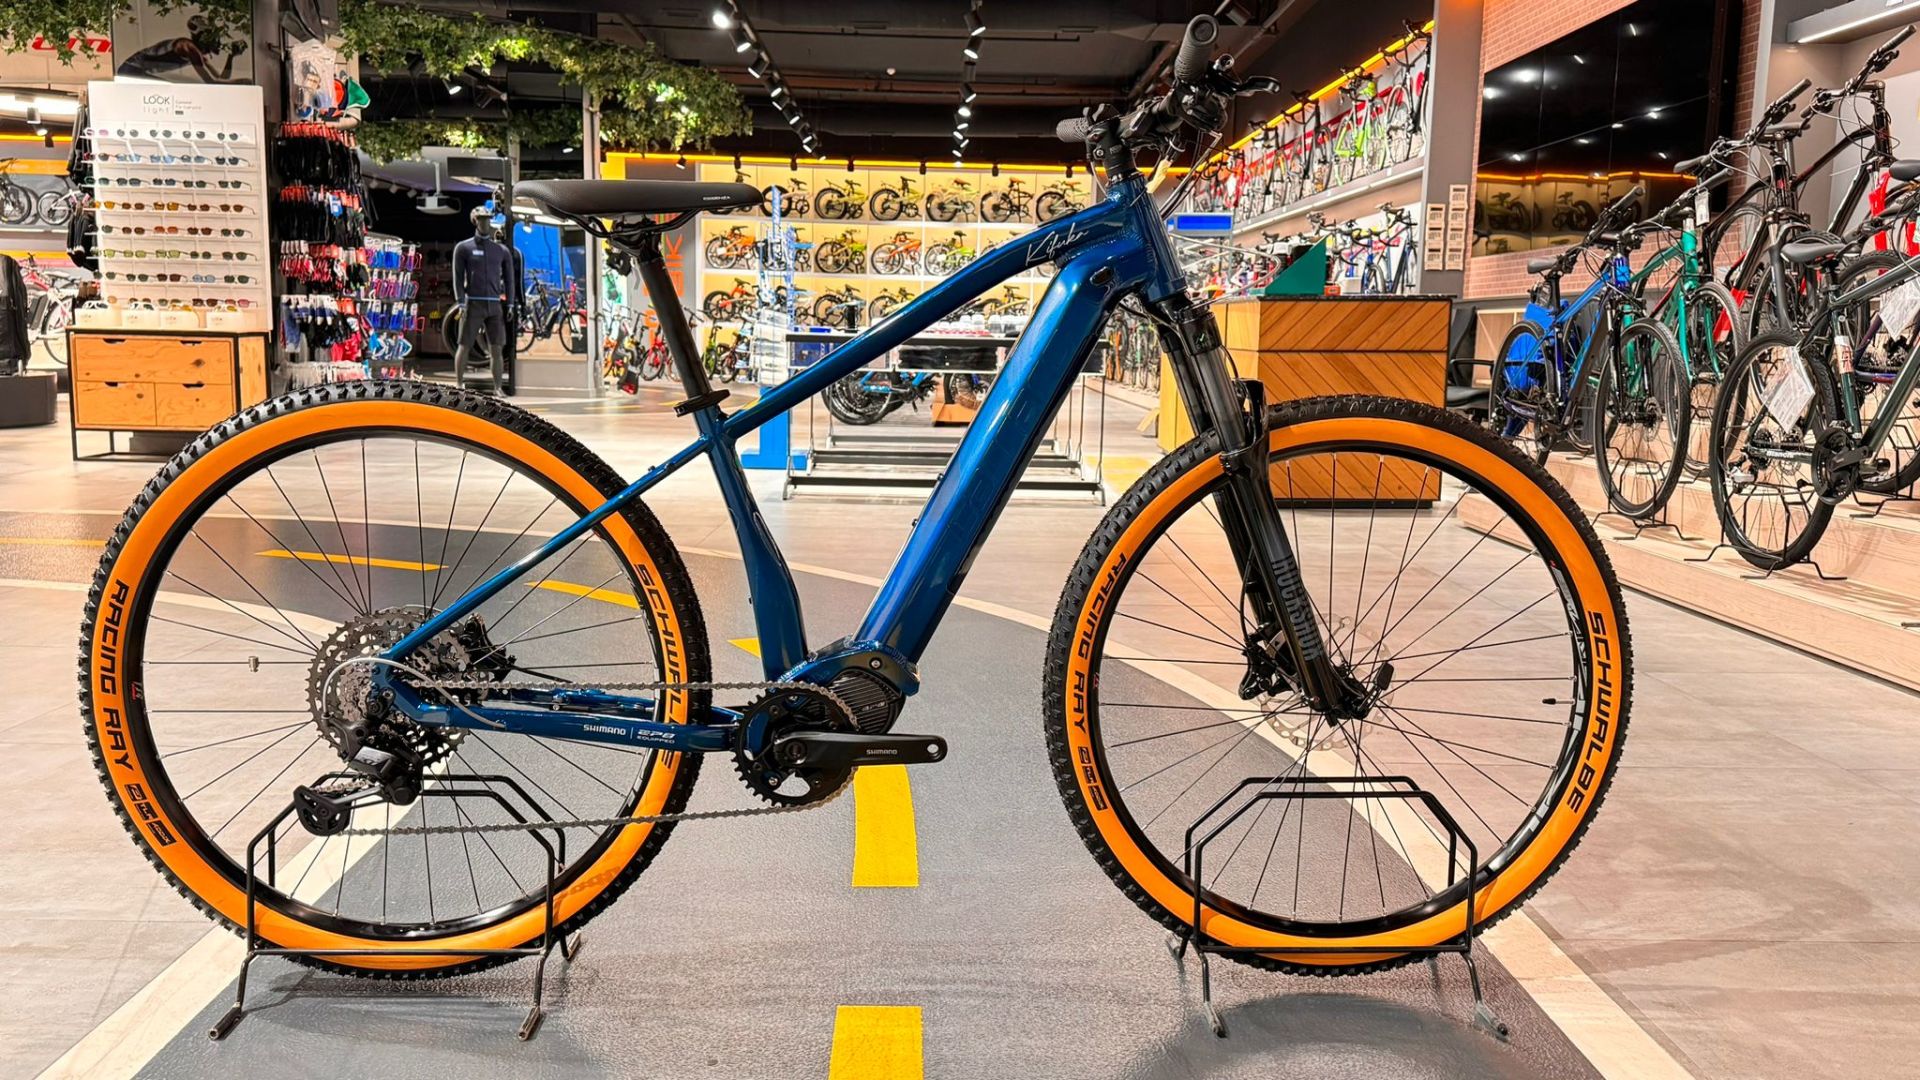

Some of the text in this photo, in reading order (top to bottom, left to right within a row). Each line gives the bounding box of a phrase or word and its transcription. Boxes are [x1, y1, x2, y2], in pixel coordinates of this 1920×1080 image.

[143, 95, 170, 105] LOOK
[100, 579, 134, 771] RACING RAY
[583, 724, 627, 736] SHIMANO
[1072, 552, 1127, 734] RACING RAY
[1565, 610, 1613, 814] SCHWALBE
